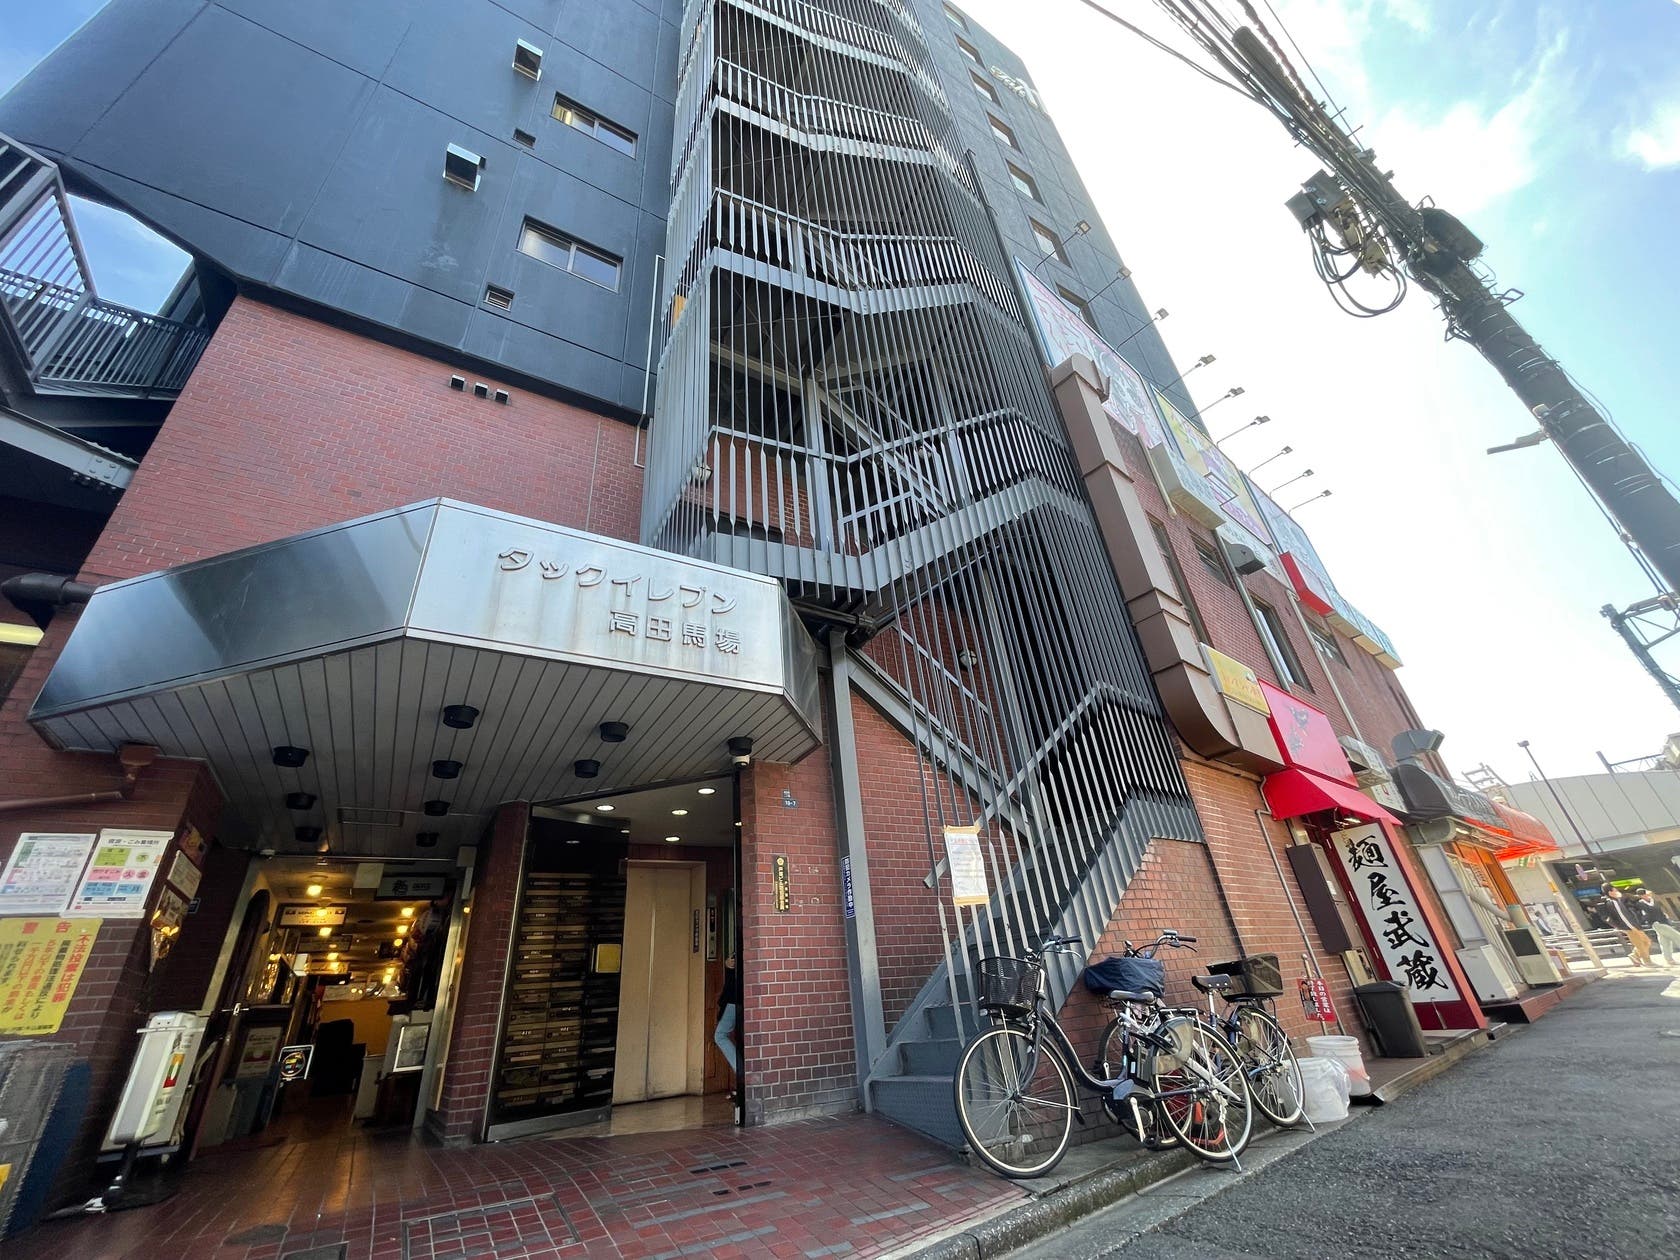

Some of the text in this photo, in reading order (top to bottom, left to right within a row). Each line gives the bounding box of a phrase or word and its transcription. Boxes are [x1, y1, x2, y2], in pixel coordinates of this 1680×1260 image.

[498, 545, 738, 615] タックイレブン
[609, 610, 742, 655] 高田馬場
[1346, 834, 1449, 991] 麺屋武蔵
[51, 934, 93, 1003] 不法投棄は犯罪
